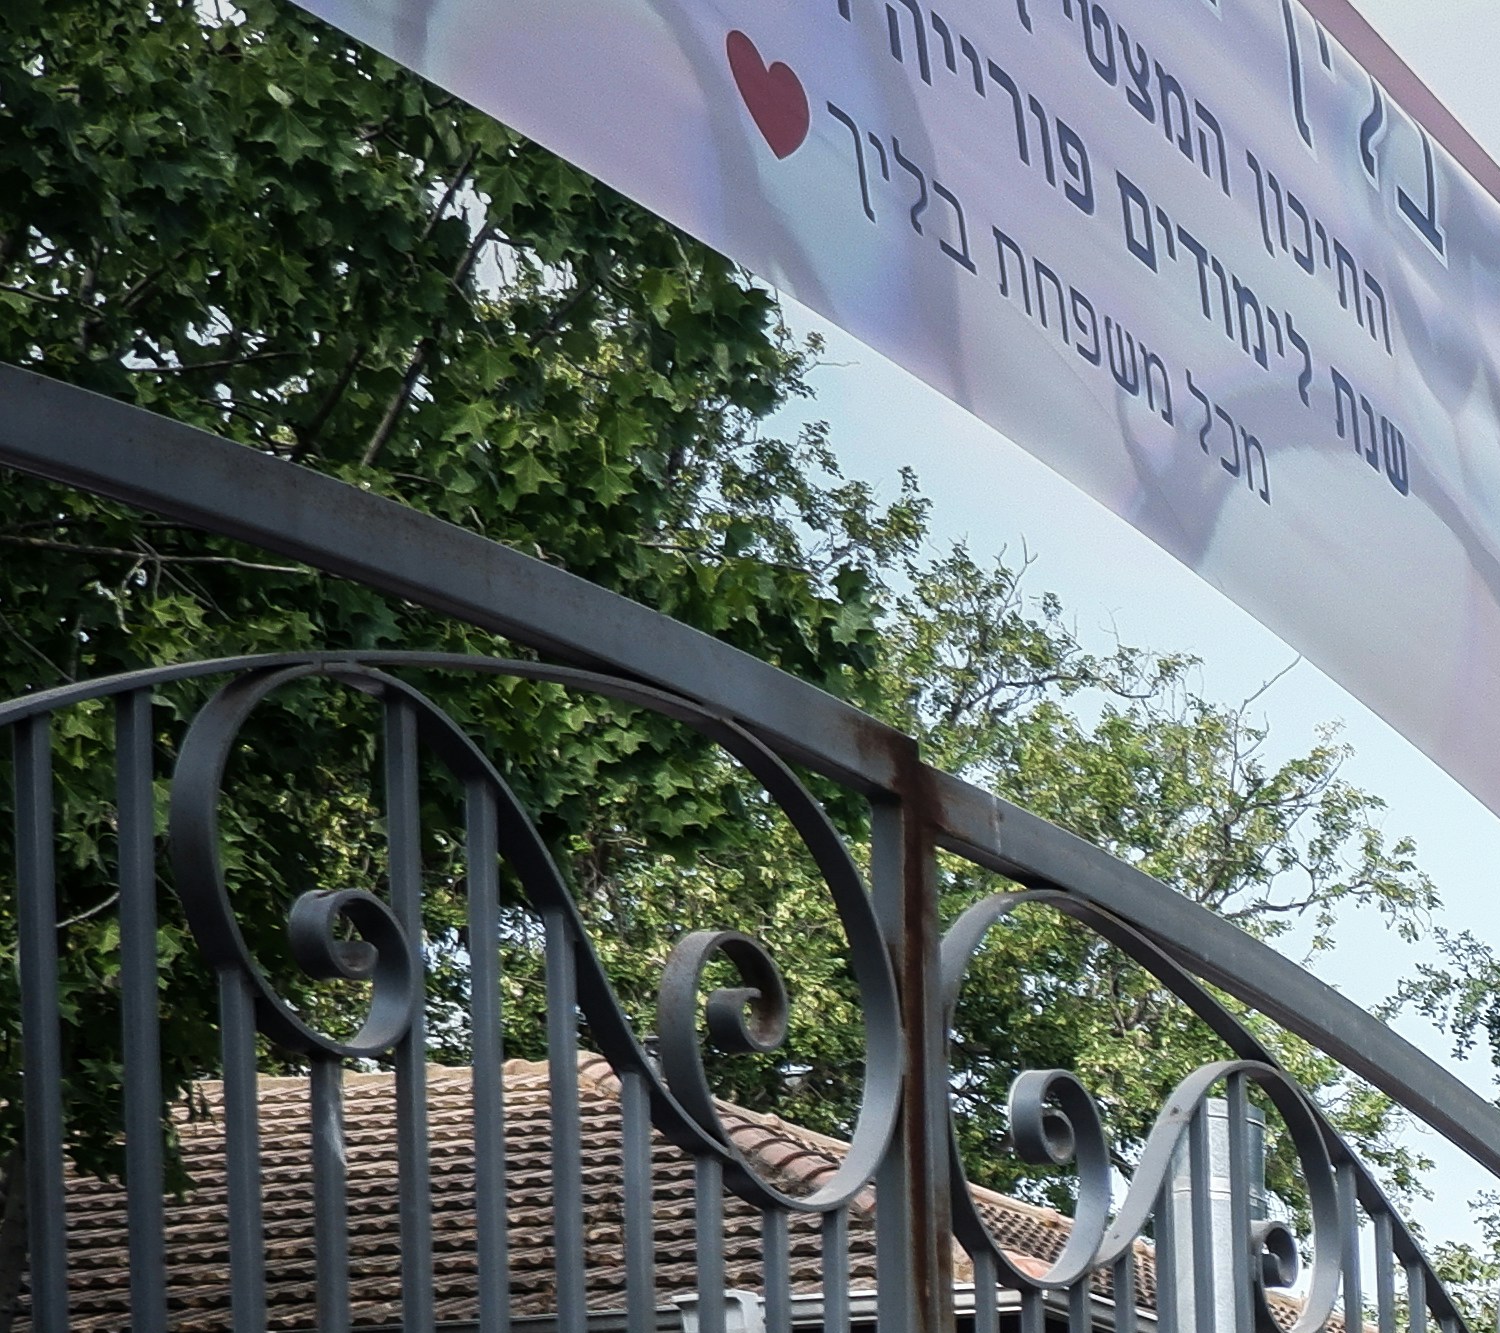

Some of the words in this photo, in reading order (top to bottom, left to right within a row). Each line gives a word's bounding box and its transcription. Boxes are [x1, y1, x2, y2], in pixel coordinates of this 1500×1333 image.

[827, 100, 977, 275] בליך
[1246, 148, 1392, 357] התיכון
[993, 225, 1174, 427] משפחת
[1115, 168, 1313, 408] לימודים
[1186, 368, 1271, 506] מכל
[1330, 365, 1409, 498] שנת
